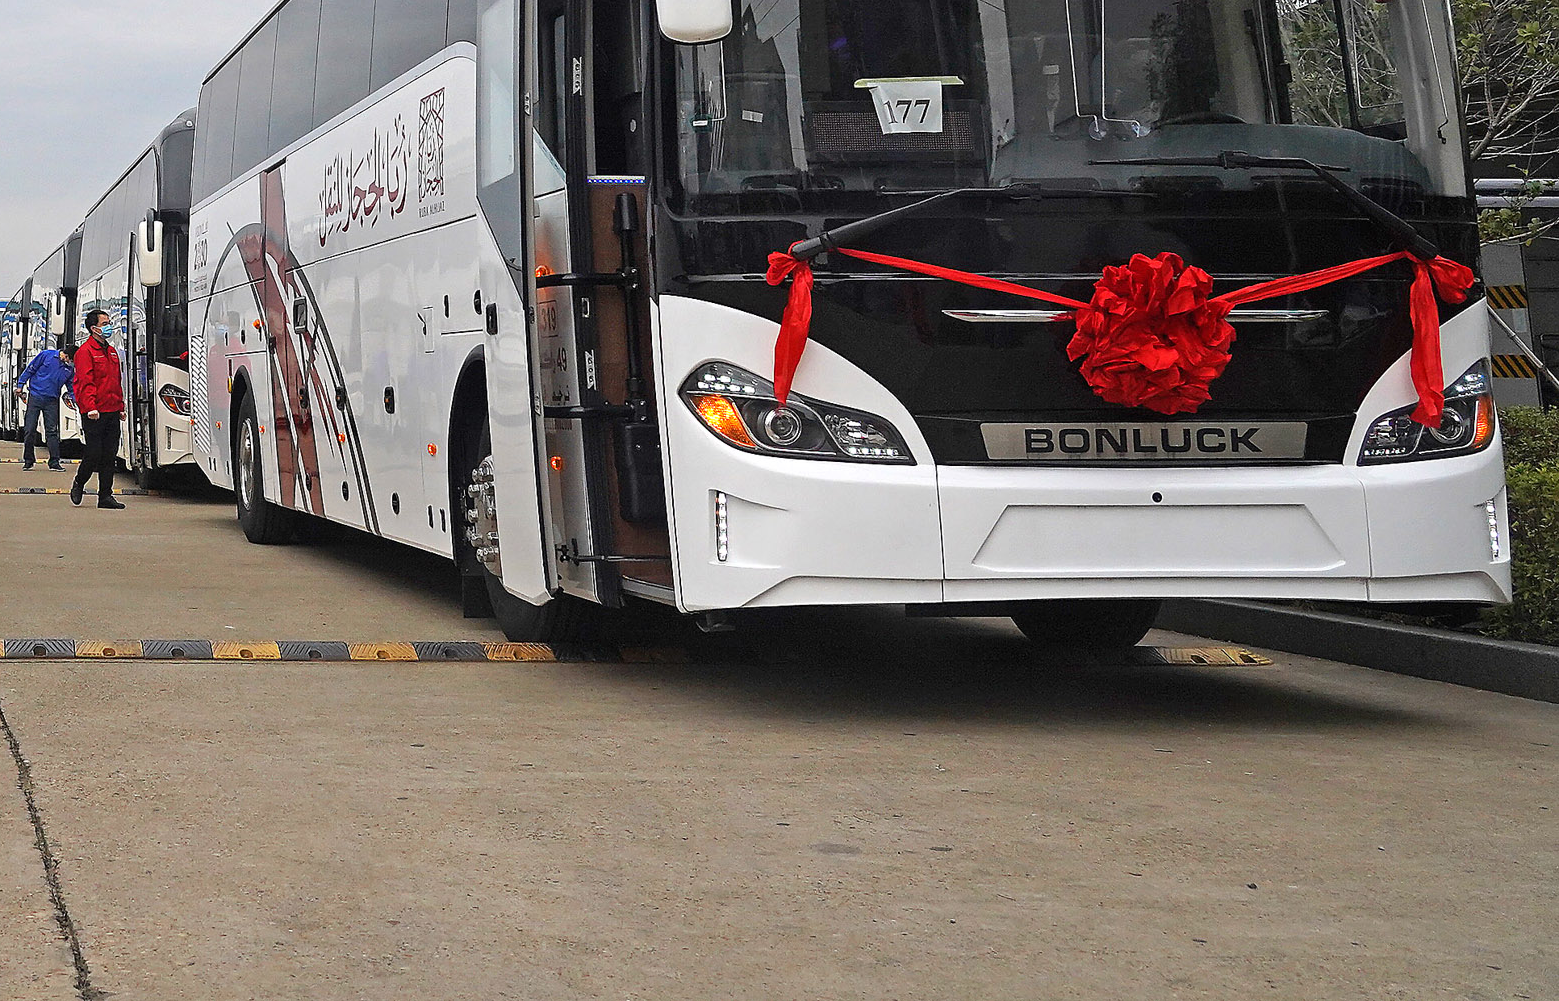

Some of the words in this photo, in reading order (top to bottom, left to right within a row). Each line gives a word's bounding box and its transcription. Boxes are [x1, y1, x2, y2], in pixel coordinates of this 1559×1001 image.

[883, 99, 931, 125] 177
[541, 306, 556, 332] 319
[556, 347, 567, 372] 49
[1024, 427, 1263, 454] BONLUCK
